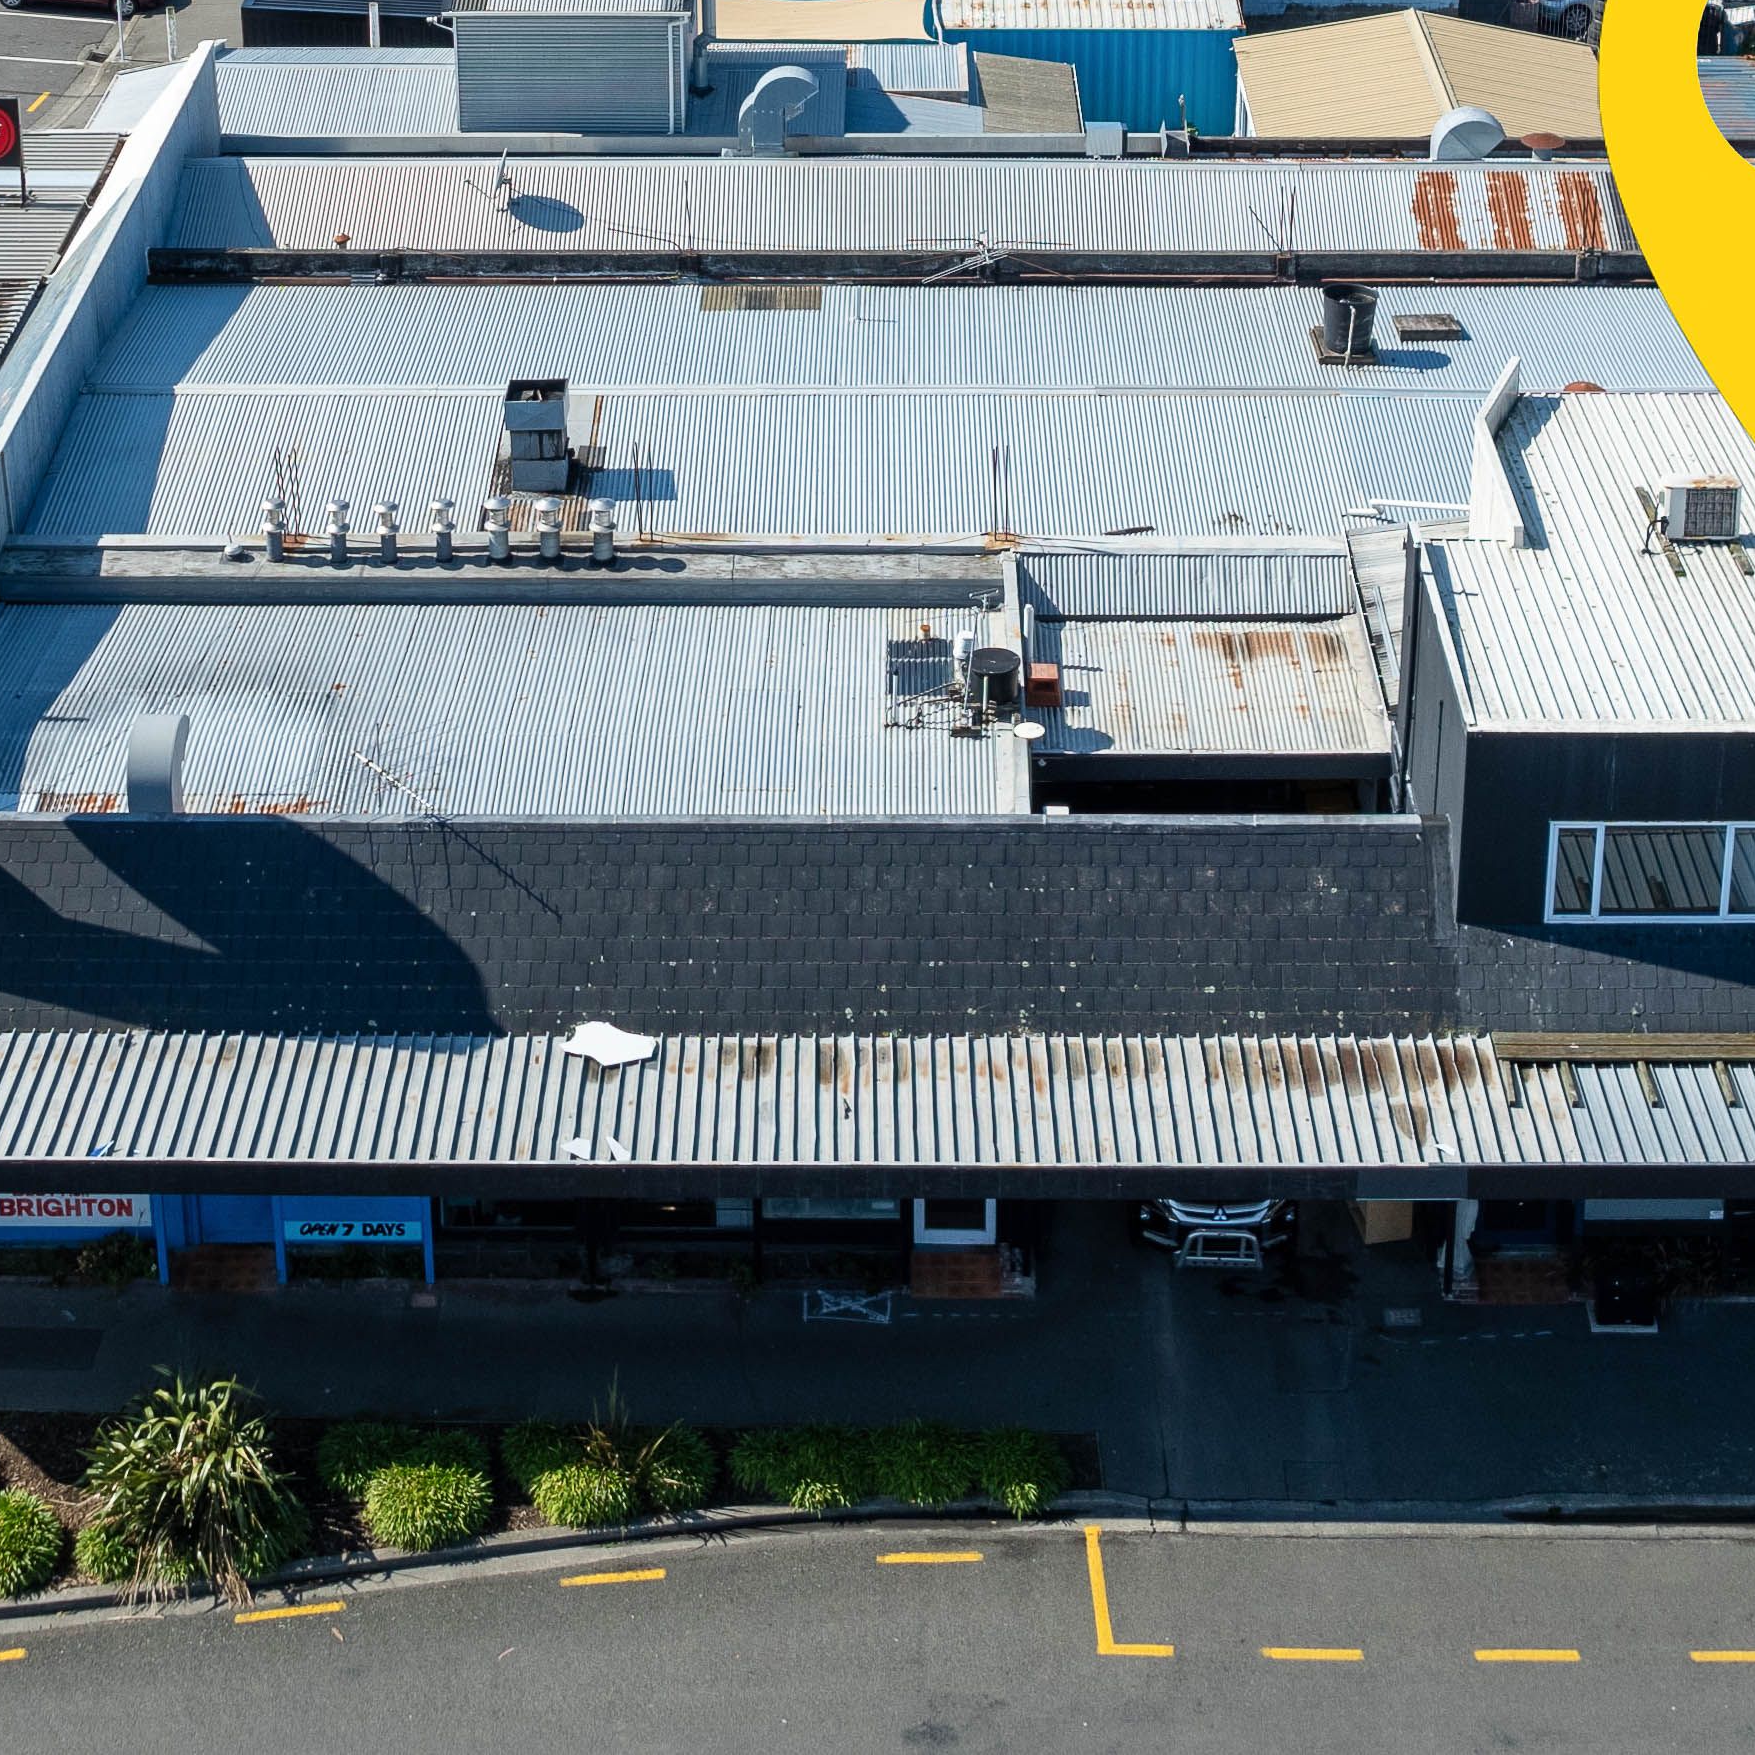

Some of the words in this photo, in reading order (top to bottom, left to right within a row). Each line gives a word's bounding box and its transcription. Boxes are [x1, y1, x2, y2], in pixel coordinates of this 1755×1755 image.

[0, 1197, 133, 1217] BRIGHTON
[300, 1222, 339, 1236] OPEN
[342, 1223, 355, 1236] 7
[362, 1223, 406, 1236] DAYS
